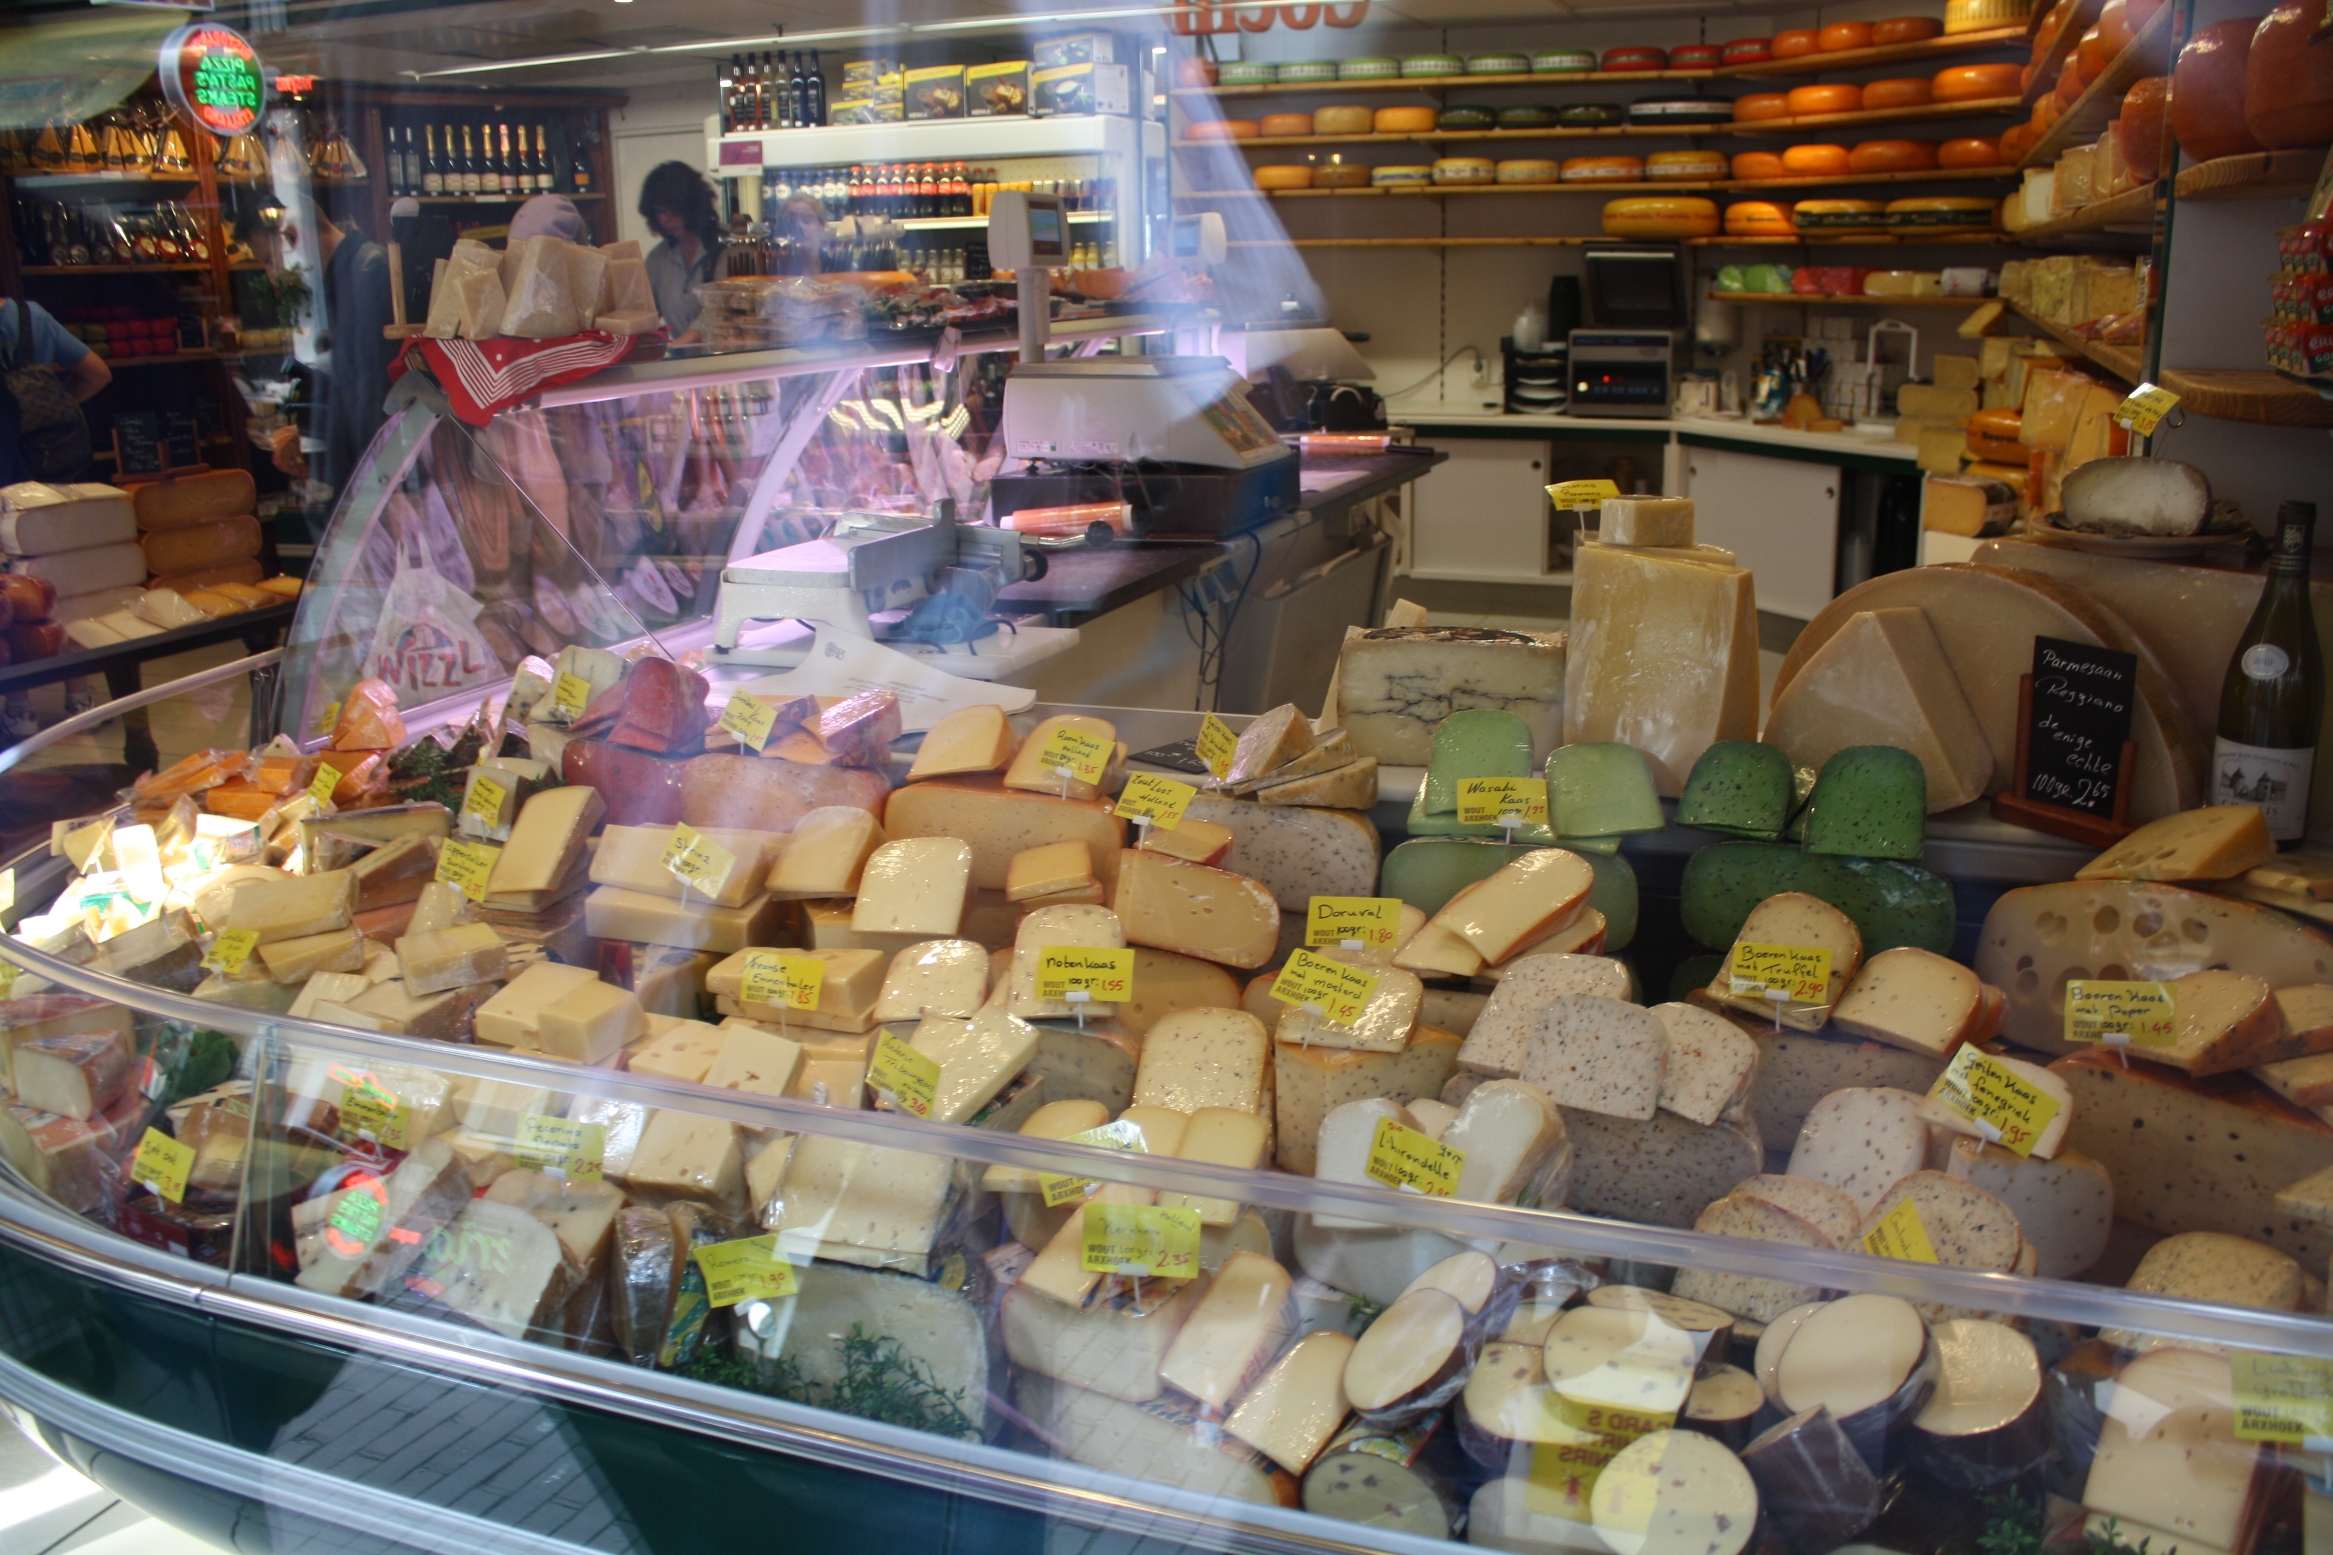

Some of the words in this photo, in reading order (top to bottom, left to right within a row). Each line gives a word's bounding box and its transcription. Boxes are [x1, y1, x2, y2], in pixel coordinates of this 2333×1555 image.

[378, 639, 485, 691] WIZZL
[2042, 649, 2123, 681] Parmesaan
[2035, 675, 2124, 713] Reggiano
[2038, 714, 2059, 730] de
[2052, 730, 2093, 751] enige
[2065, 752, 2113, 775] echte
[1467, 781, 1517, 794] Wasabi
[1499, 793, 1531, 805] Kaas
[1463, 807, 1486, 815] WOUT
[1464, 814, 1498, 822] ARXHOEK
[1523, 805, 1545, 820] 1.95
[1318, 904, 1382, 919] Doruval
[1370, 928, 1393, 943] 1.80
[1742, 945, 1786, 961] Boeren
[1297, 952, 1338, 975] Boeren
[1736, 962, 1758, 971] met
[1761, 963, 1818, 979] Truffel
[1043, 981, 1065, 989] WOUT
[1280, 977, 1303, 989] WOUT
[1290, 969, 1307, 980] met
[1313, 978, 1363, 1000] mosterd
[1794, 980, 1824, 998] 2.90
[1275, 985, 1310, 1002] ARXHOEK
[1328, 998, 1357, 1018] 1.45
[2071, 986, 2122, 1001] Boeren
[2076, 1004, 2099, 1014] met
[2108, 1004, 2151, 1018] Peper
[2073, 1020, 2098, 1029] WOUT
[2141, 1021, 2172, 1037] 1.45
[1963, 1052, 2002, 1082] Geiten
[1945, 1078, 1970, 1098] WOUT
[1952, 1068, 1969, 1080] met
[1973, 1076, 2032, 1124] fenegriek
[1938, 1087, 1978, 1116] ARXHOEK
[2000, 1116, 2032, 1144] 1.95
[525, 1117, 582, 1137] Pecorino
[1373, 1155, 1394, 1171] WOUT
[1047, 1177, 1074, 1192] WOUT
[1160, 1210, 1196, 1232] Holland
[1087, 1244, 1115, 1253] WOUT
[1156, 1249, 1192, 1268] 2.35
[760, 1272, 786, 1290] 1.90
[2242, 1418, 2304, 1434] ARXHOEK
